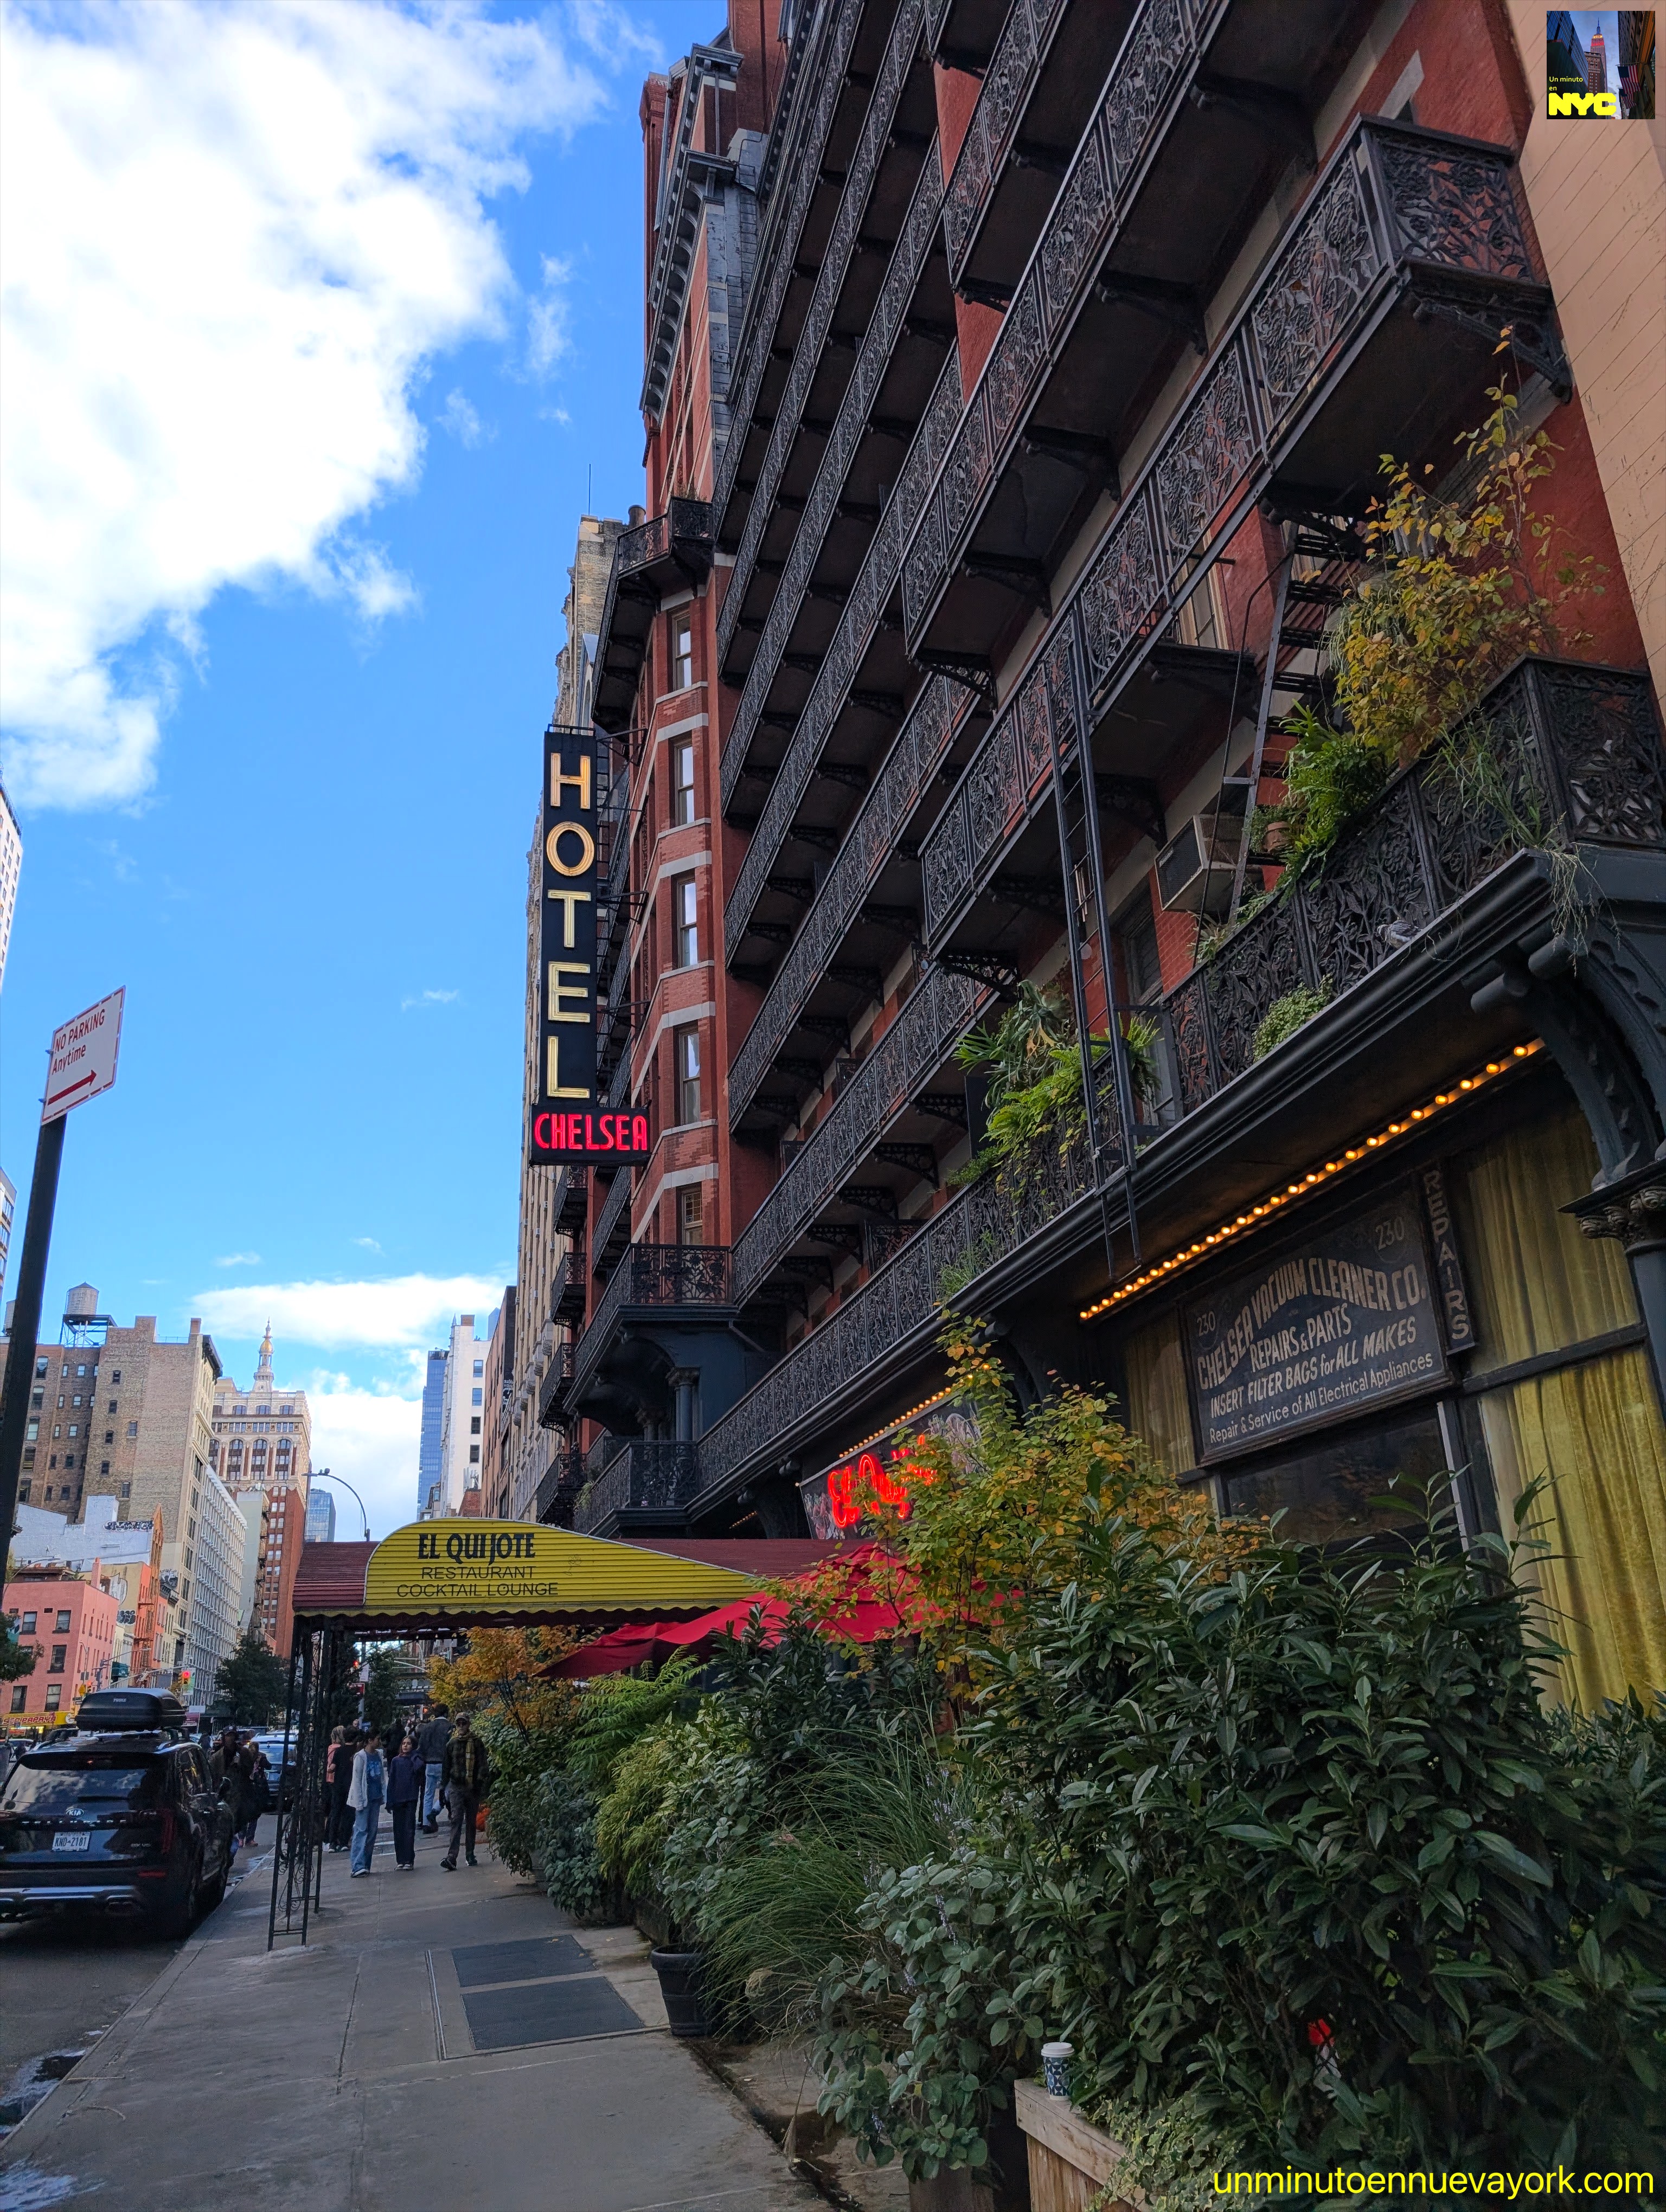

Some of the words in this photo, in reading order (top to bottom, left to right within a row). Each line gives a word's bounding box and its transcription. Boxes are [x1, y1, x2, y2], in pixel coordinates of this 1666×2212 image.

[546, 753, 595, 1099] HOTEL
[55, 1033, 66, 1052] NO
[68, 1008, 105, 1045] PARKING
[52, 1044, 86, 1074] Anytime
[534, 1113, 648, 1151] CHELSEA
[1375, 1216, 1405, 1250] 230
[1424, 1169, 1470, 1340] REPAIRS
[1197, 1311, 1216, 1336] 230
[1197, 1306, 1253, 1390] CHELSEA
[1251, 1259, 1308, 1329] VACUUM
[1309, 1258, 1392, 1311] CLEANER
[1392, 1264, 1426, 1310] CO.
[1250, 1326, 1299, 1373] REPAIRS
[1300, 1333, 1309, 1352] &
[1306, 1302, 1351, 1349] PARTS
[1210, 1385, 1244, 1418] INSERT
[1248, 1371, 1283, 1404] FILTER
[1285, 1356, 1318, 1390] BAGS
[1320, 1353, 1335, 1377] for
[1336, 1340, 1359, 1371] ALL
[1363, 1316, 1417, 1360] MAKES
[1209, 1420, 1238, 1444] Repair
[1241, 1416, 1247, 1433] &
[1248, 1406, 1289, 1431] Service
[1292, 1395, 1302, 1415] of
[1305, 1390, 1317, 1411] All
[1318, 1371, 1369, 1406] Electrical
[1370, 1353, 1433, 1388] Appliances
[417, 1533, 440, 1559] EL
[446, 1533, 536, 1565] QUIJOTE
[397, 1584, 482, 1597] COCKTAIL
[488, 1582, 559, 1596] LOUNGE
[421, 1566, 536, 1579] RESTAURANT
[22, 1715, 56, 1724] PAPAYA
